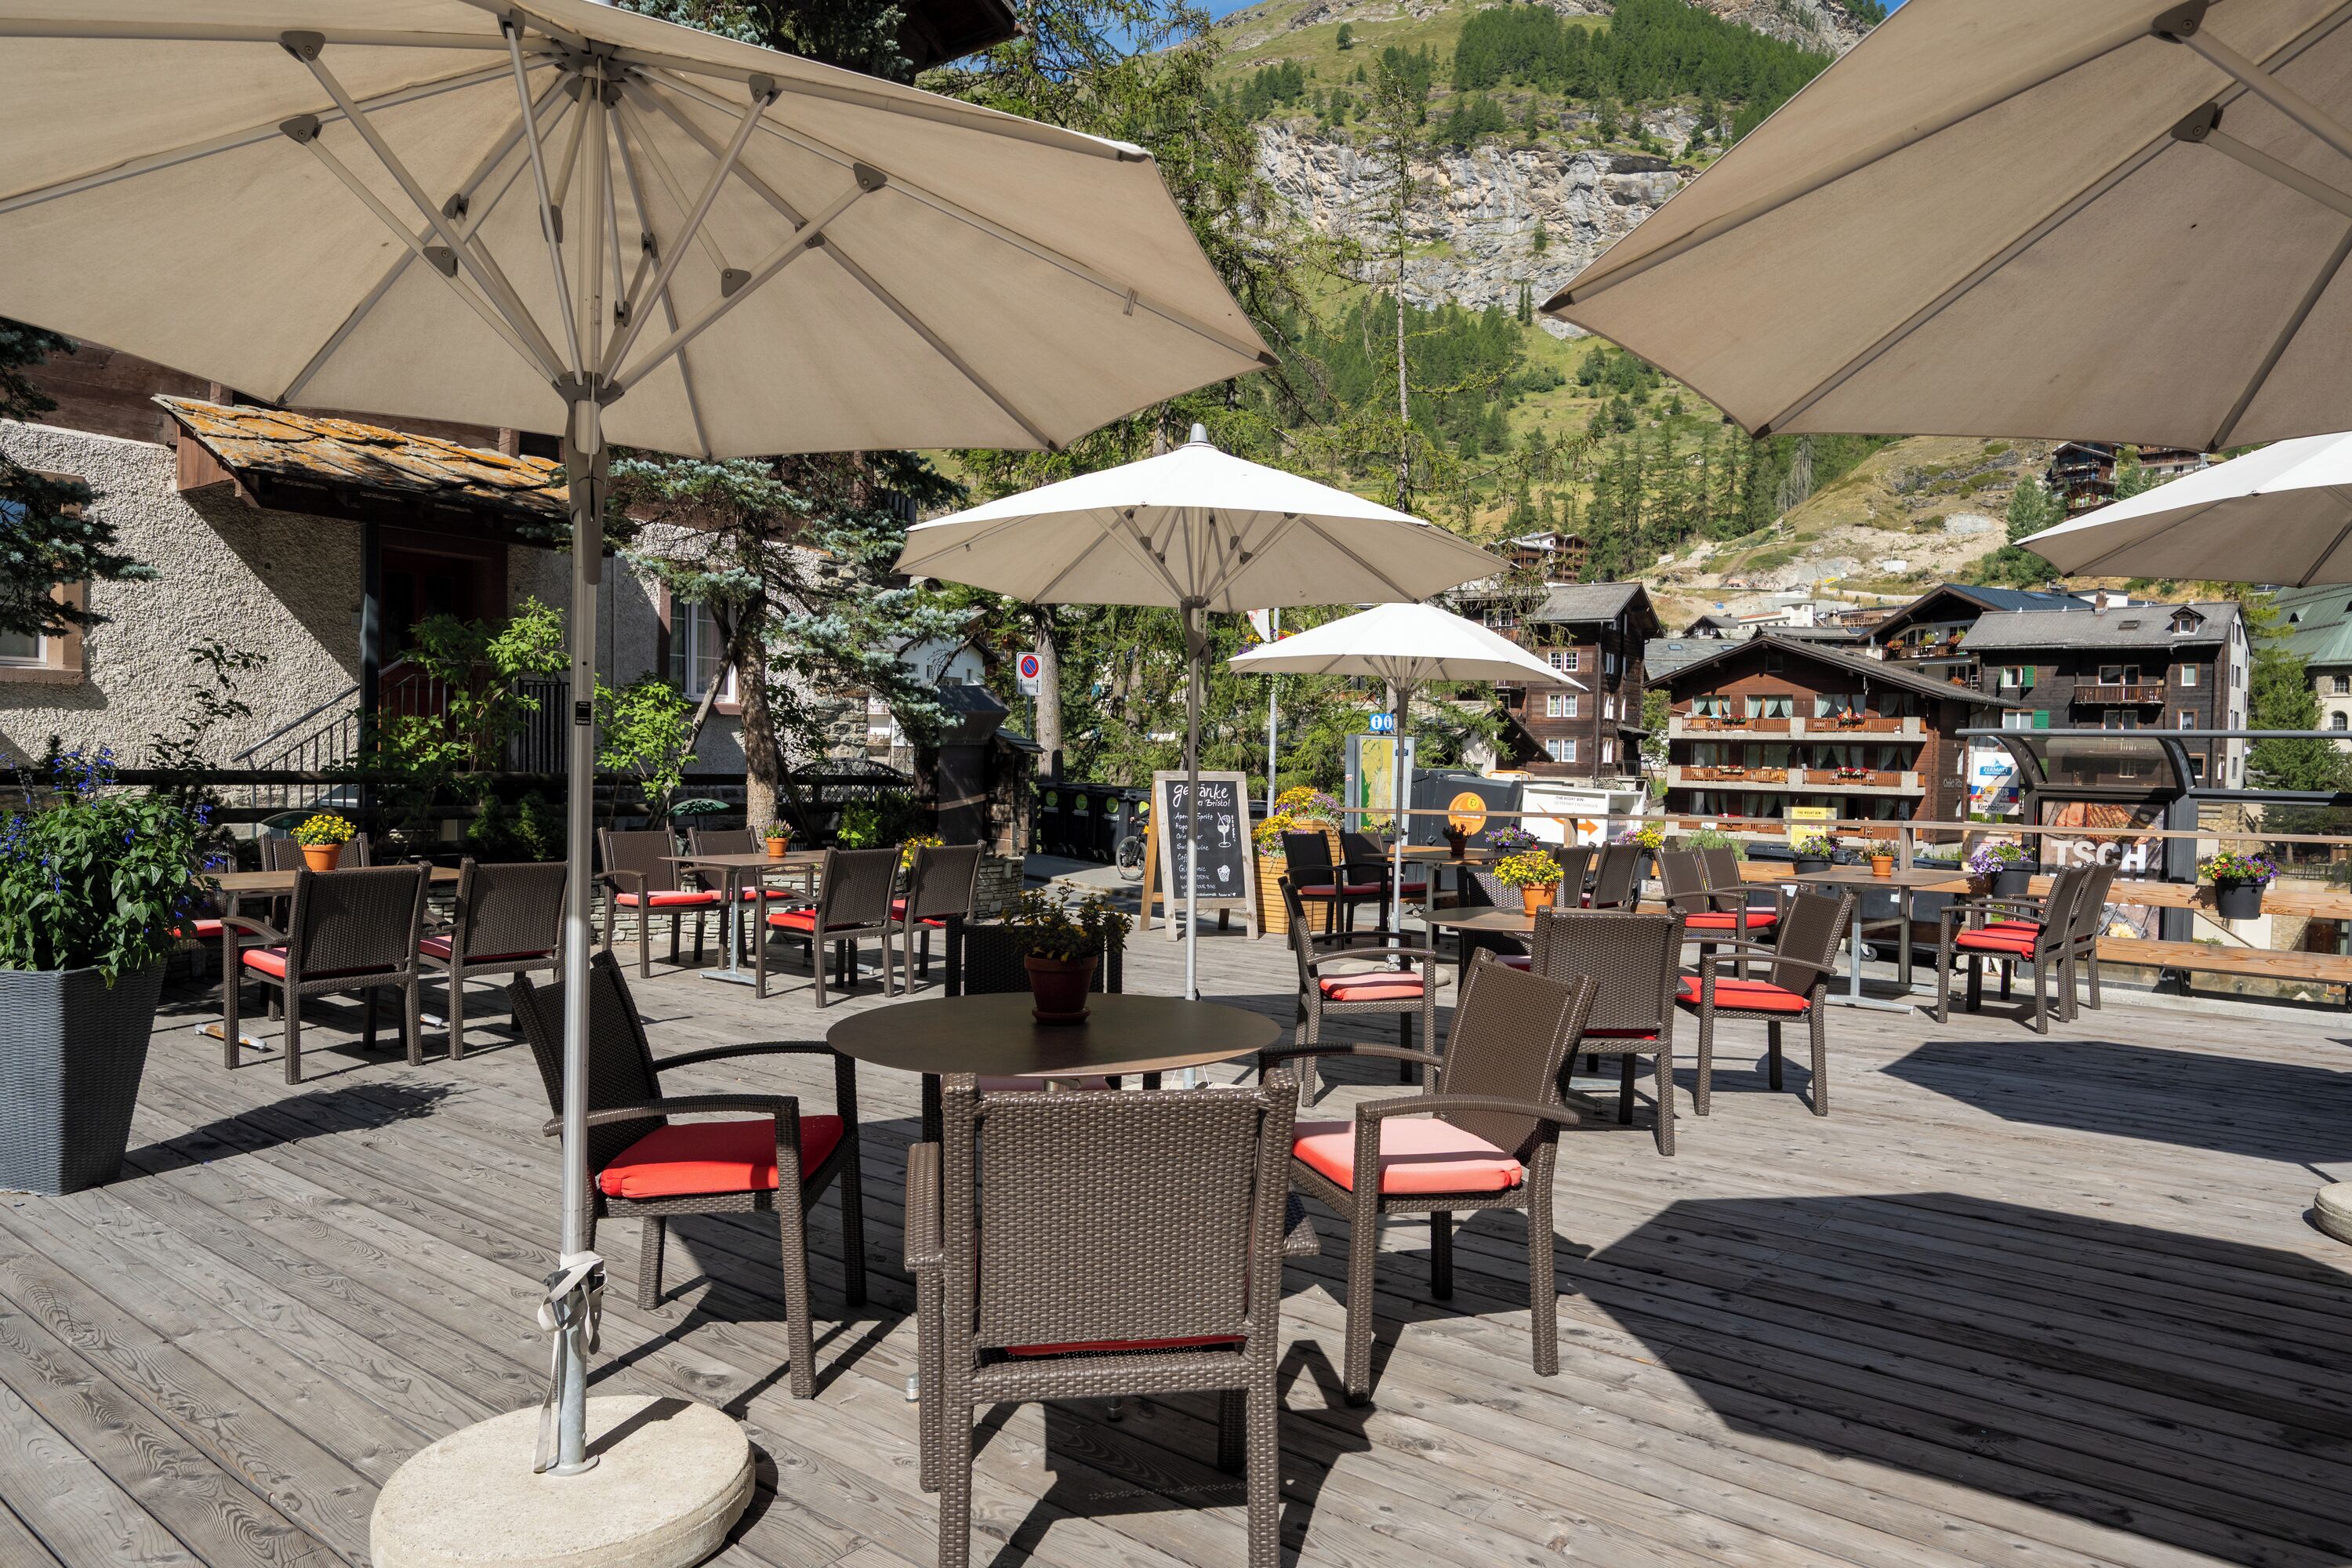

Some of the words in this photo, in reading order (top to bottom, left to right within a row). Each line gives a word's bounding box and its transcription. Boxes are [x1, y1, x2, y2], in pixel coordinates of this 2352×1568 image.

[1173, 783, 1229, 808] geänke
[1205, 798, 1230, 808] Bristol
[1175, 822, 1189, 833] Hugo
[2051, 840, 2147, 873] TSCH
